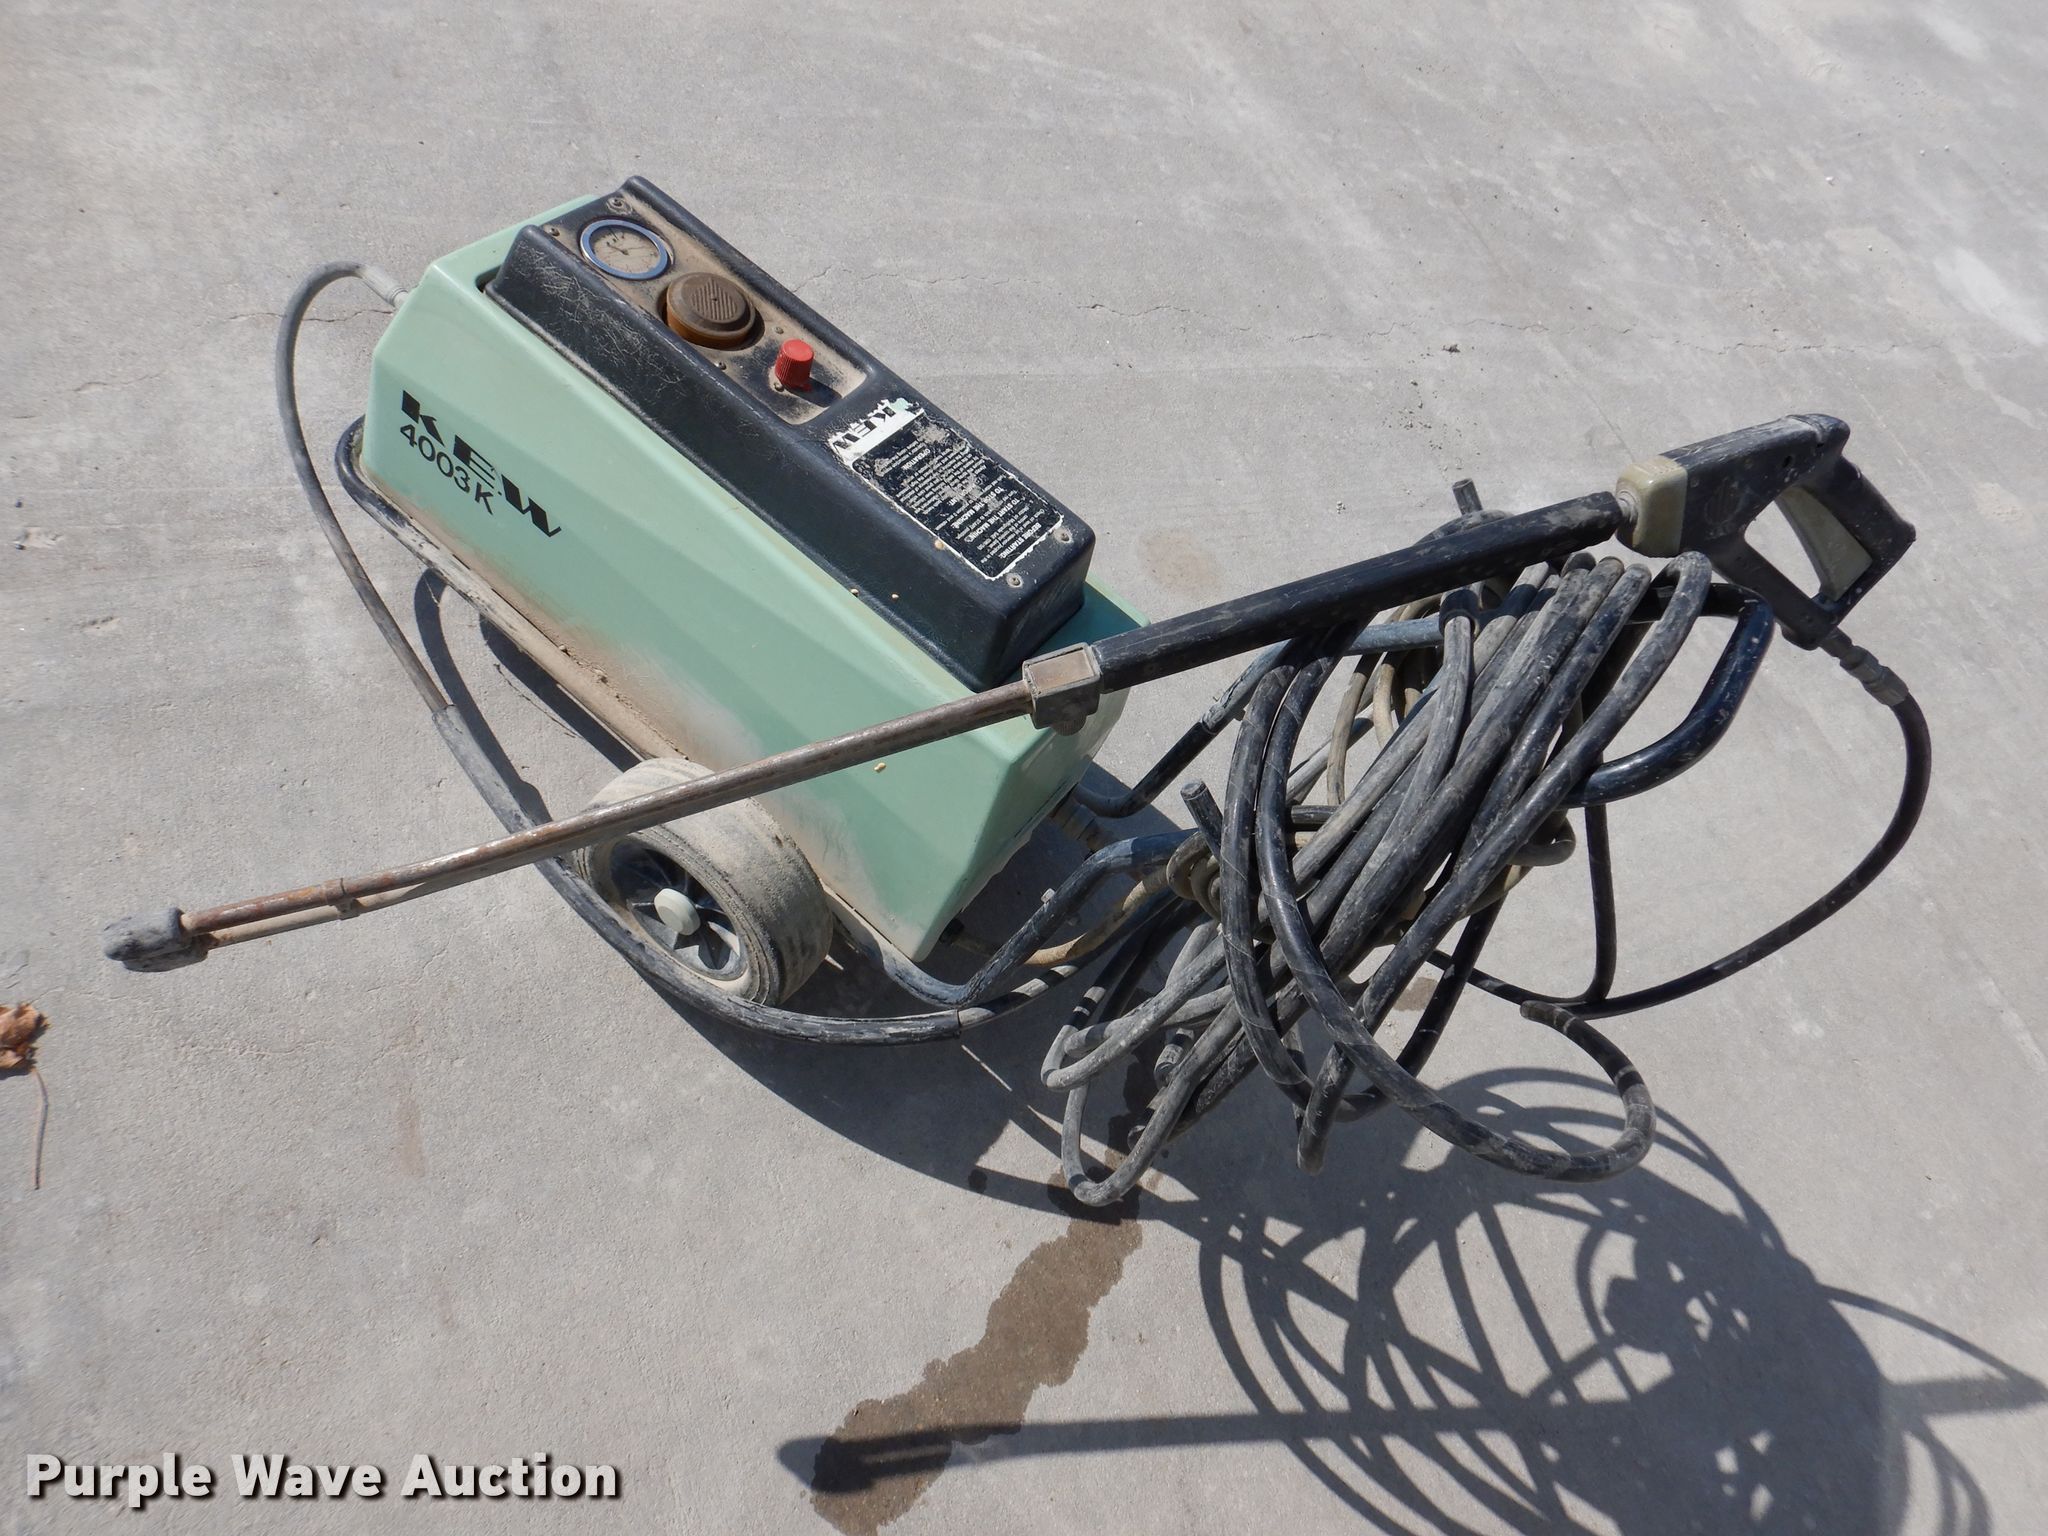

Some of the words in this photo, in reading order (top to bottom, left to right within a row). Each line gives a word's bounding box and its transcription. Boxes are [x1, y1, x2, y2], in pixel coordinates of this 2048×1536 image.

[833, 406, 896, 454] KEW
[401, 390, 562, 537] KEW
[1009, 497, 1020, 505] TO
[996, 502, 1013, 516] START
[986, 514, 999, 524] THE
